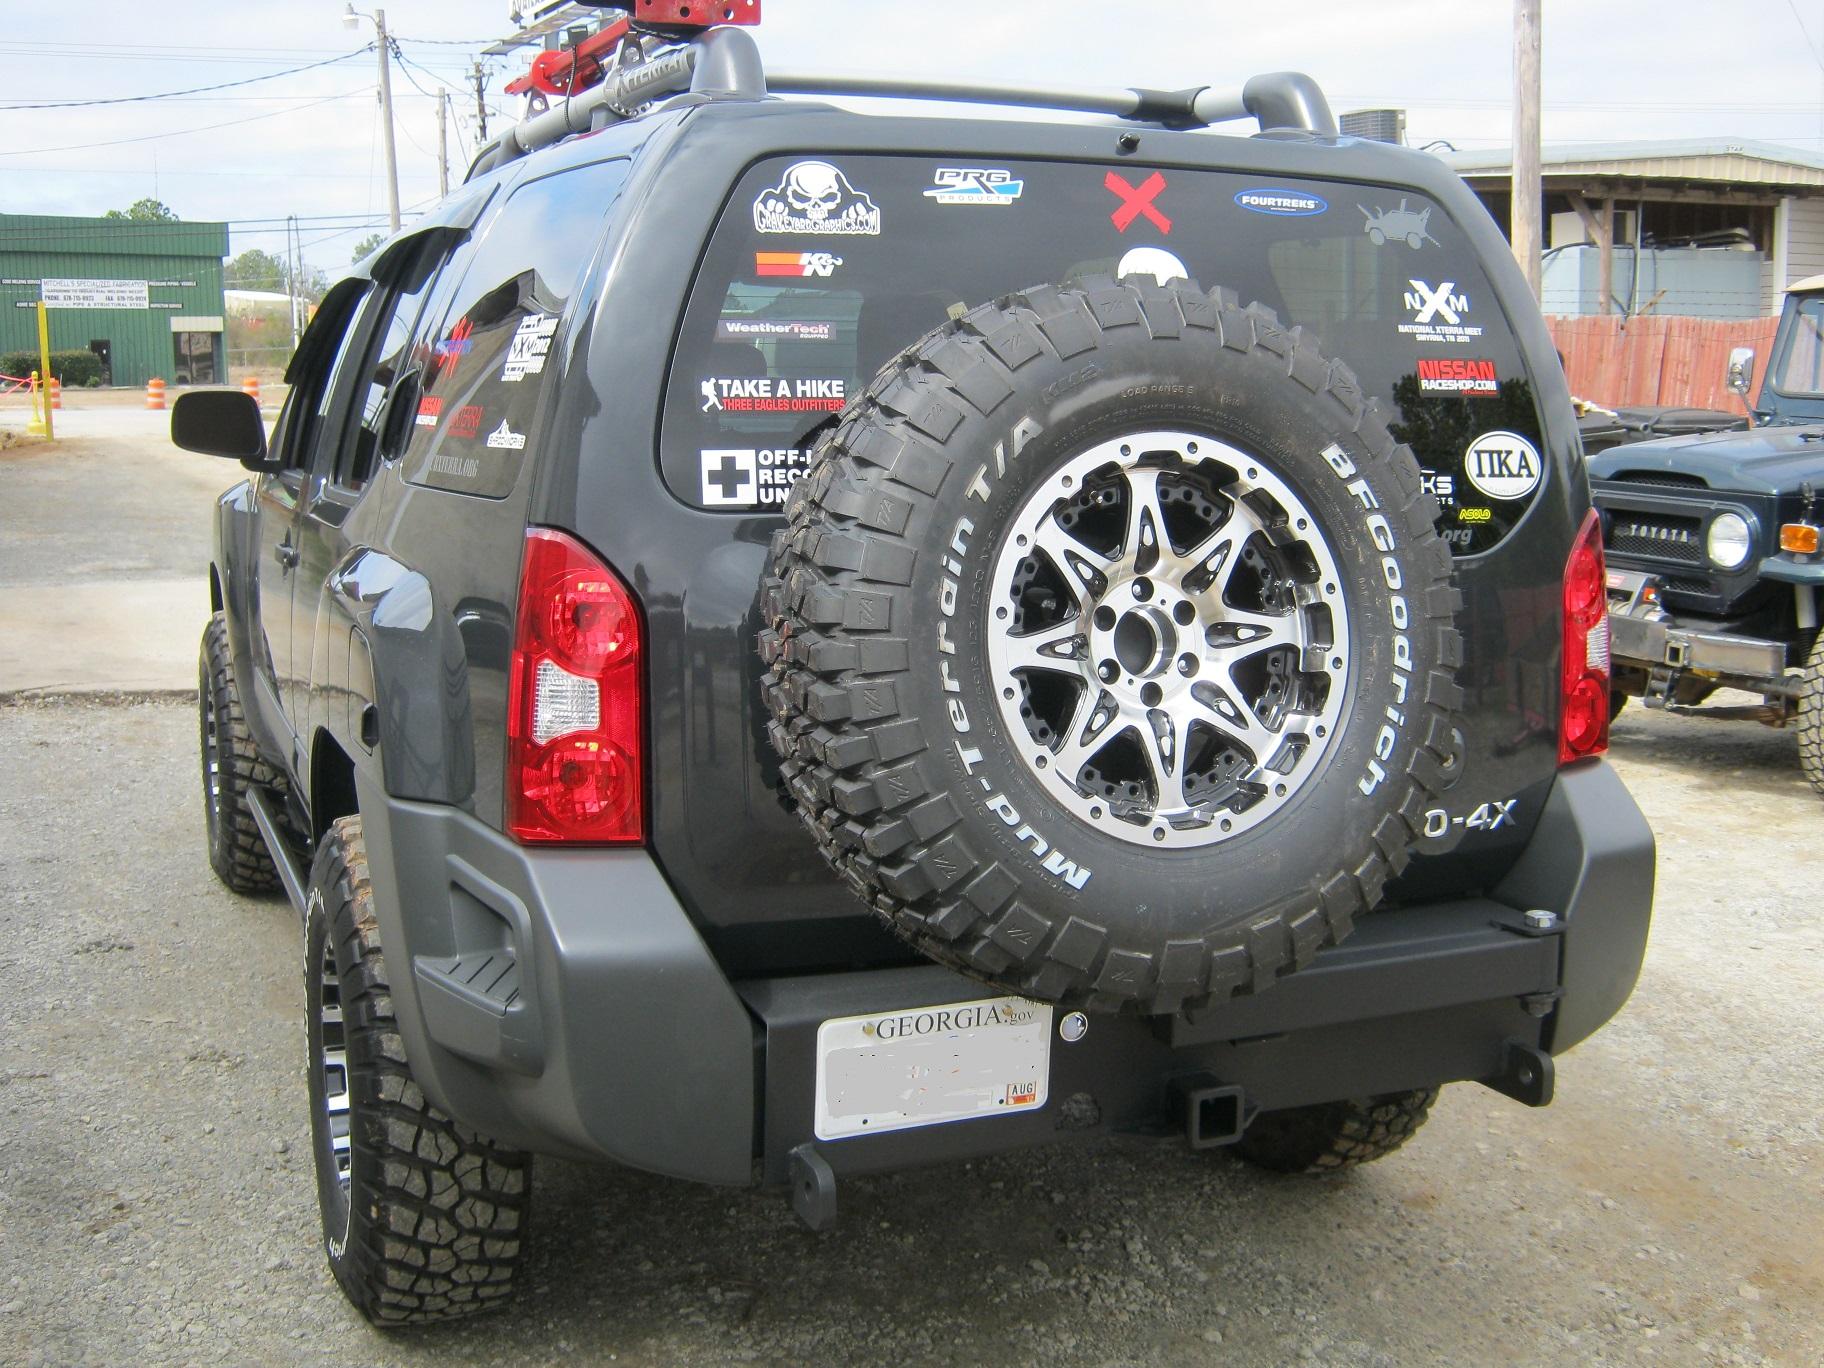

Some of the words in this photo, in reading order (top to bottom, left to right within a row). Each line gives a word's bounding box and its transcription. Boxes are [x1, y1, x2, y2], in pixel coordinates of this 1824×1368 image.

[938, 170, 1008, 186] PRG
[939, 194, 1011, 202] PRODUCTS
[1241, 195, 1319, 209] FOURTREKS
[726, 322, 830, 334] WeatherTech
[1398, 324, 1435, 334] NATIONAL
[1435, 326, 1464, 335] XTERRA
[1464, 327, 1482, 336] MEET
[1418, 360, 1495, 380] NISSAN
[718, 379, 772, 398] TAKE
[776, 379, 792, 398] A
[796, 379, 845, 398] HIKE
[1421, 379, 1497, 391] RACESHOP.COM
[723, 399, 753, 411] THREE
[755, 399, 790, 411] EAGLES
[792, 399, 846, 411] OUTFITTERS
[1420, 476, 1453, 494] KS
[759, 487, 790, 504] UN
[1441, 529, 1473, 544] org
[1630, 524, 1688, 542] TOYOTA
[1318, 443, 1413, 797] BFGoodrich
[1424, 799, 1519, 838] O-4X
[1011, 1083, 1034, 1096] AUG
